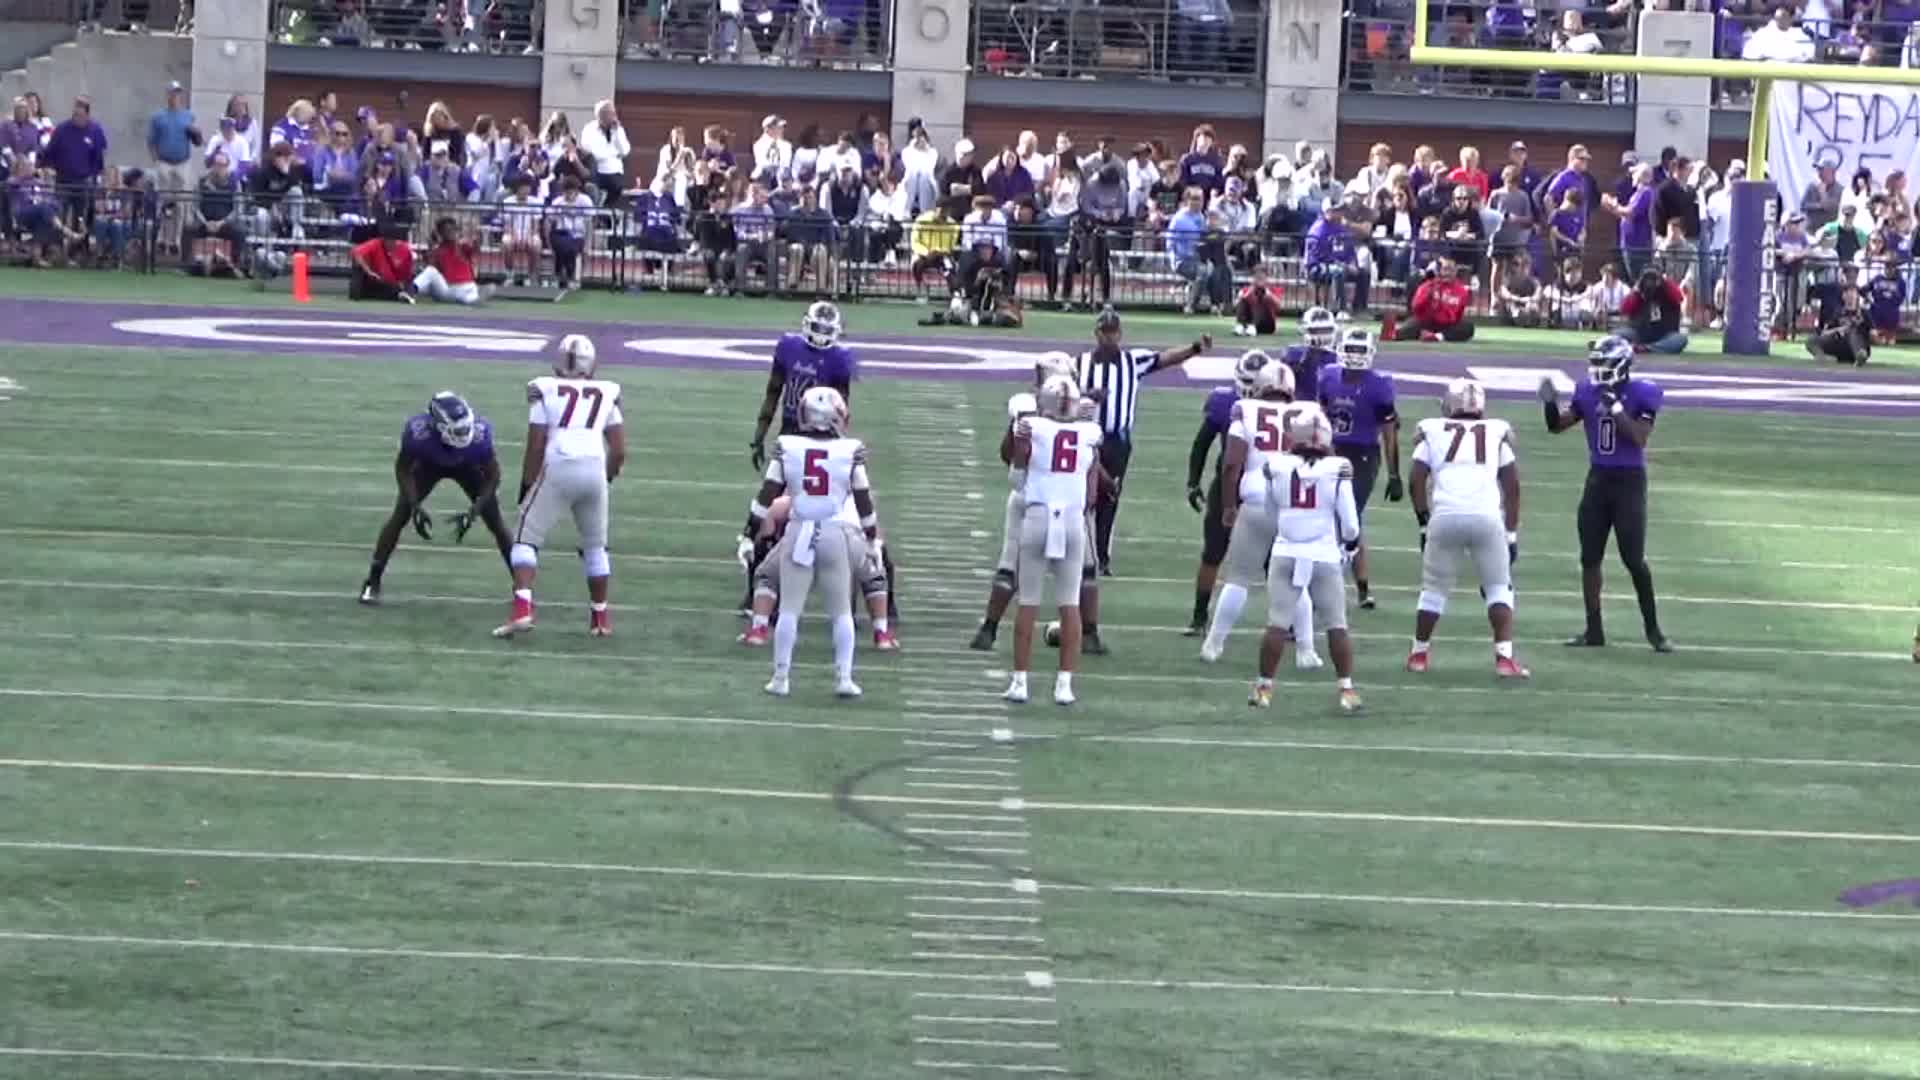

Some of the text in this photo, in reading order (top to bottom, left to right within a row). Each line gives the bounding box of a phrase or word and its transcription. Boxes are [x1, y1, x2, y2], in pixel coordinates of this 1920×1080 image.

[1795, 80, 1919, 142] REYDA
[557, 385, 603, 429] 77
[1051, 430, 1078, 473] 6
[1444, 423, 1486, 464] 71
[1598, 416, 1616, 455] 0
[803, 449, 829, 496] 5
